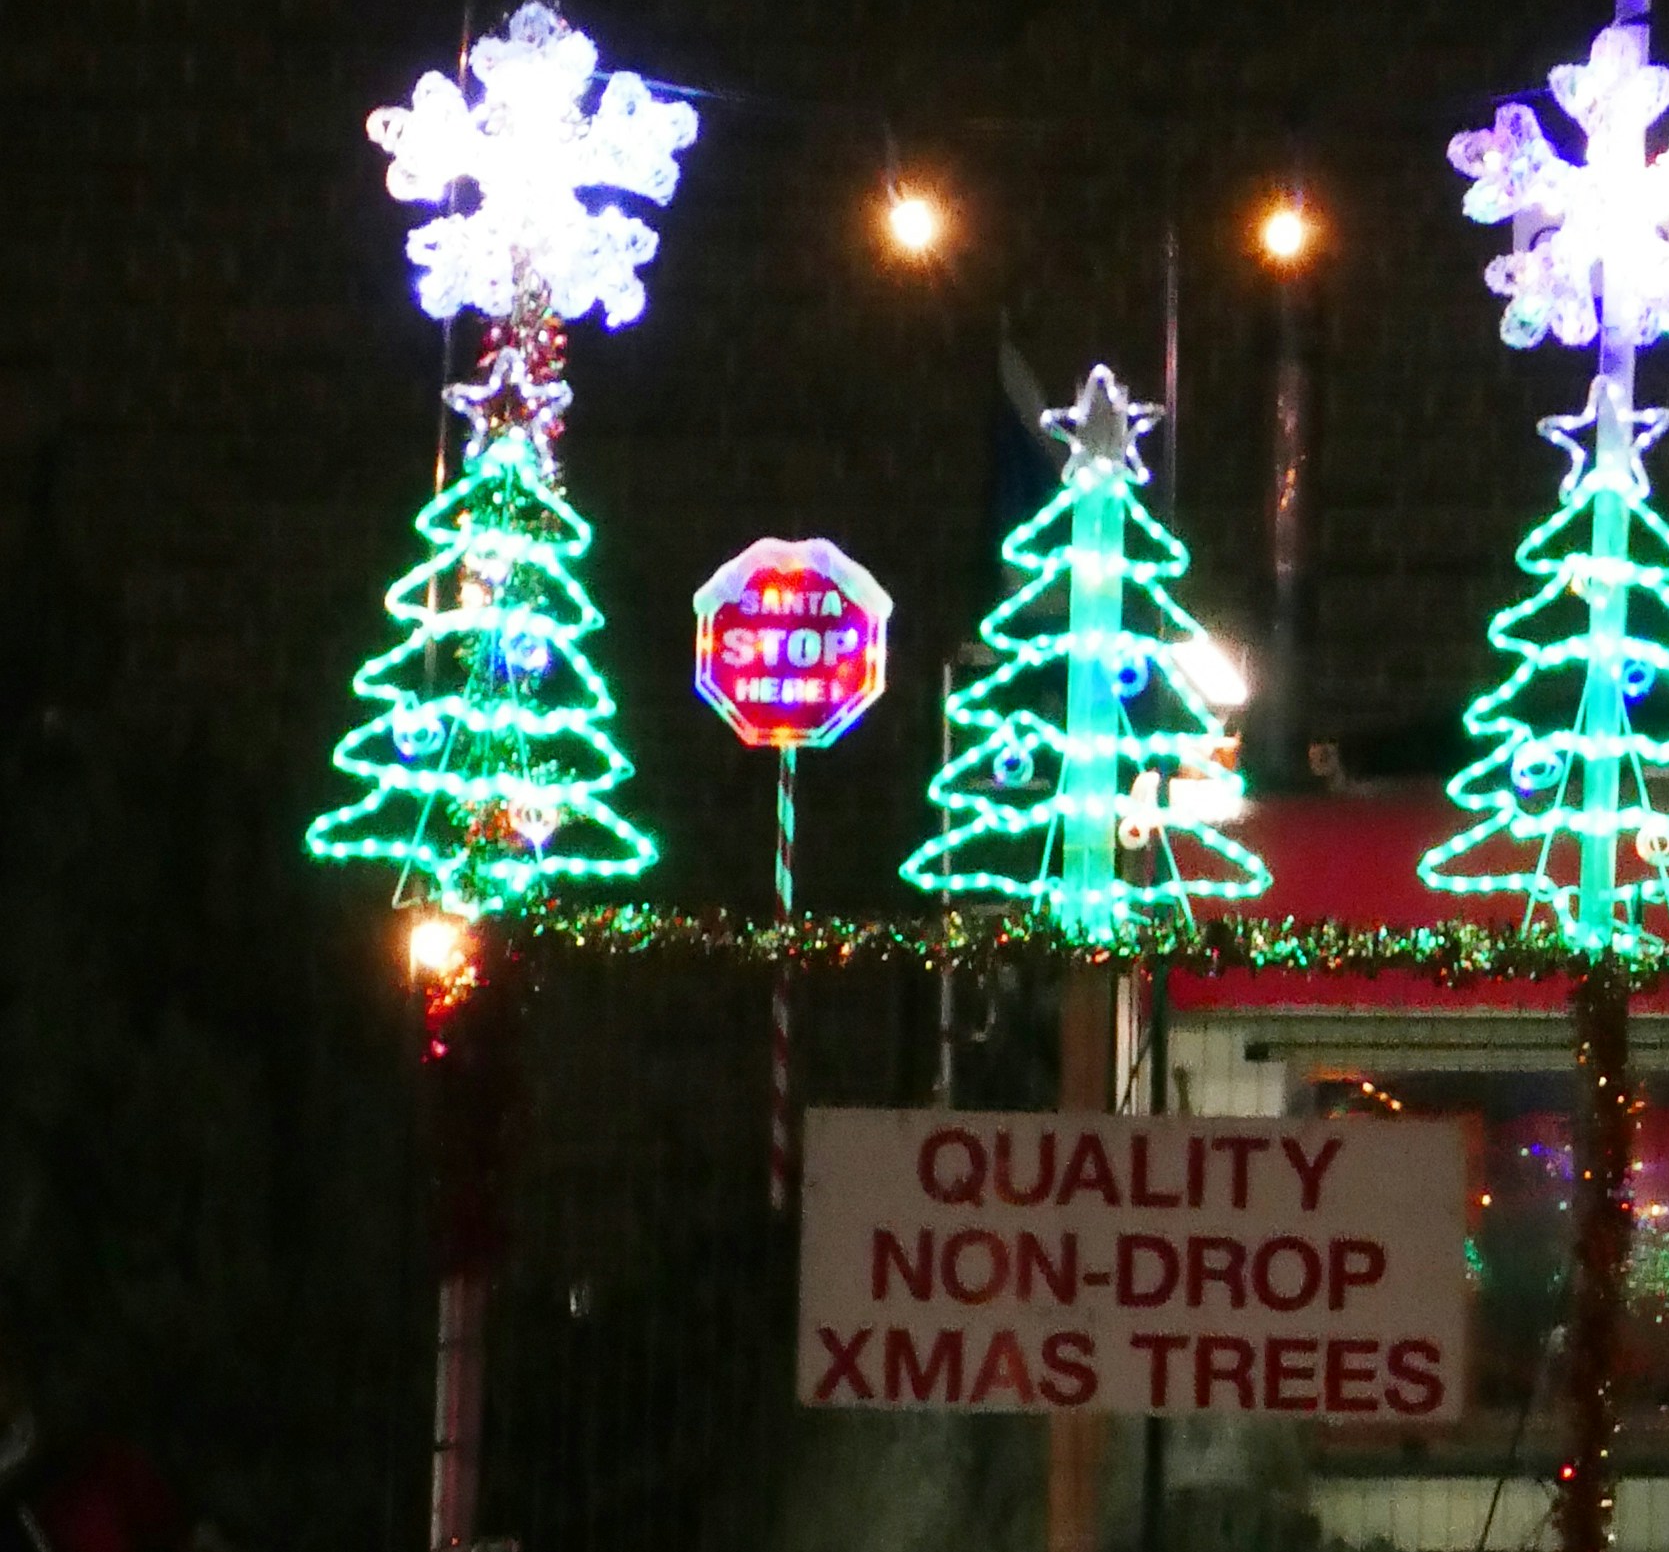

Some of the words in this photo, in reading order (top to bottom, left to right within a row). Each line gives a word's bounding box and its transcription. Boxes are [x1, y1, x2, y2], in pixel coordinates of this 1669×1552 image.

[739, 589, 843, 617] SANTA
[721, 627, 858, 668] STOP
[916, 1127, 1341, 1211] QUALITY
[871, 1227, 1386, 1311] NON-DROP
[815, 1327, 1099, 1407] XMAS
[1130, 1332, 1445, 1414] TREES
